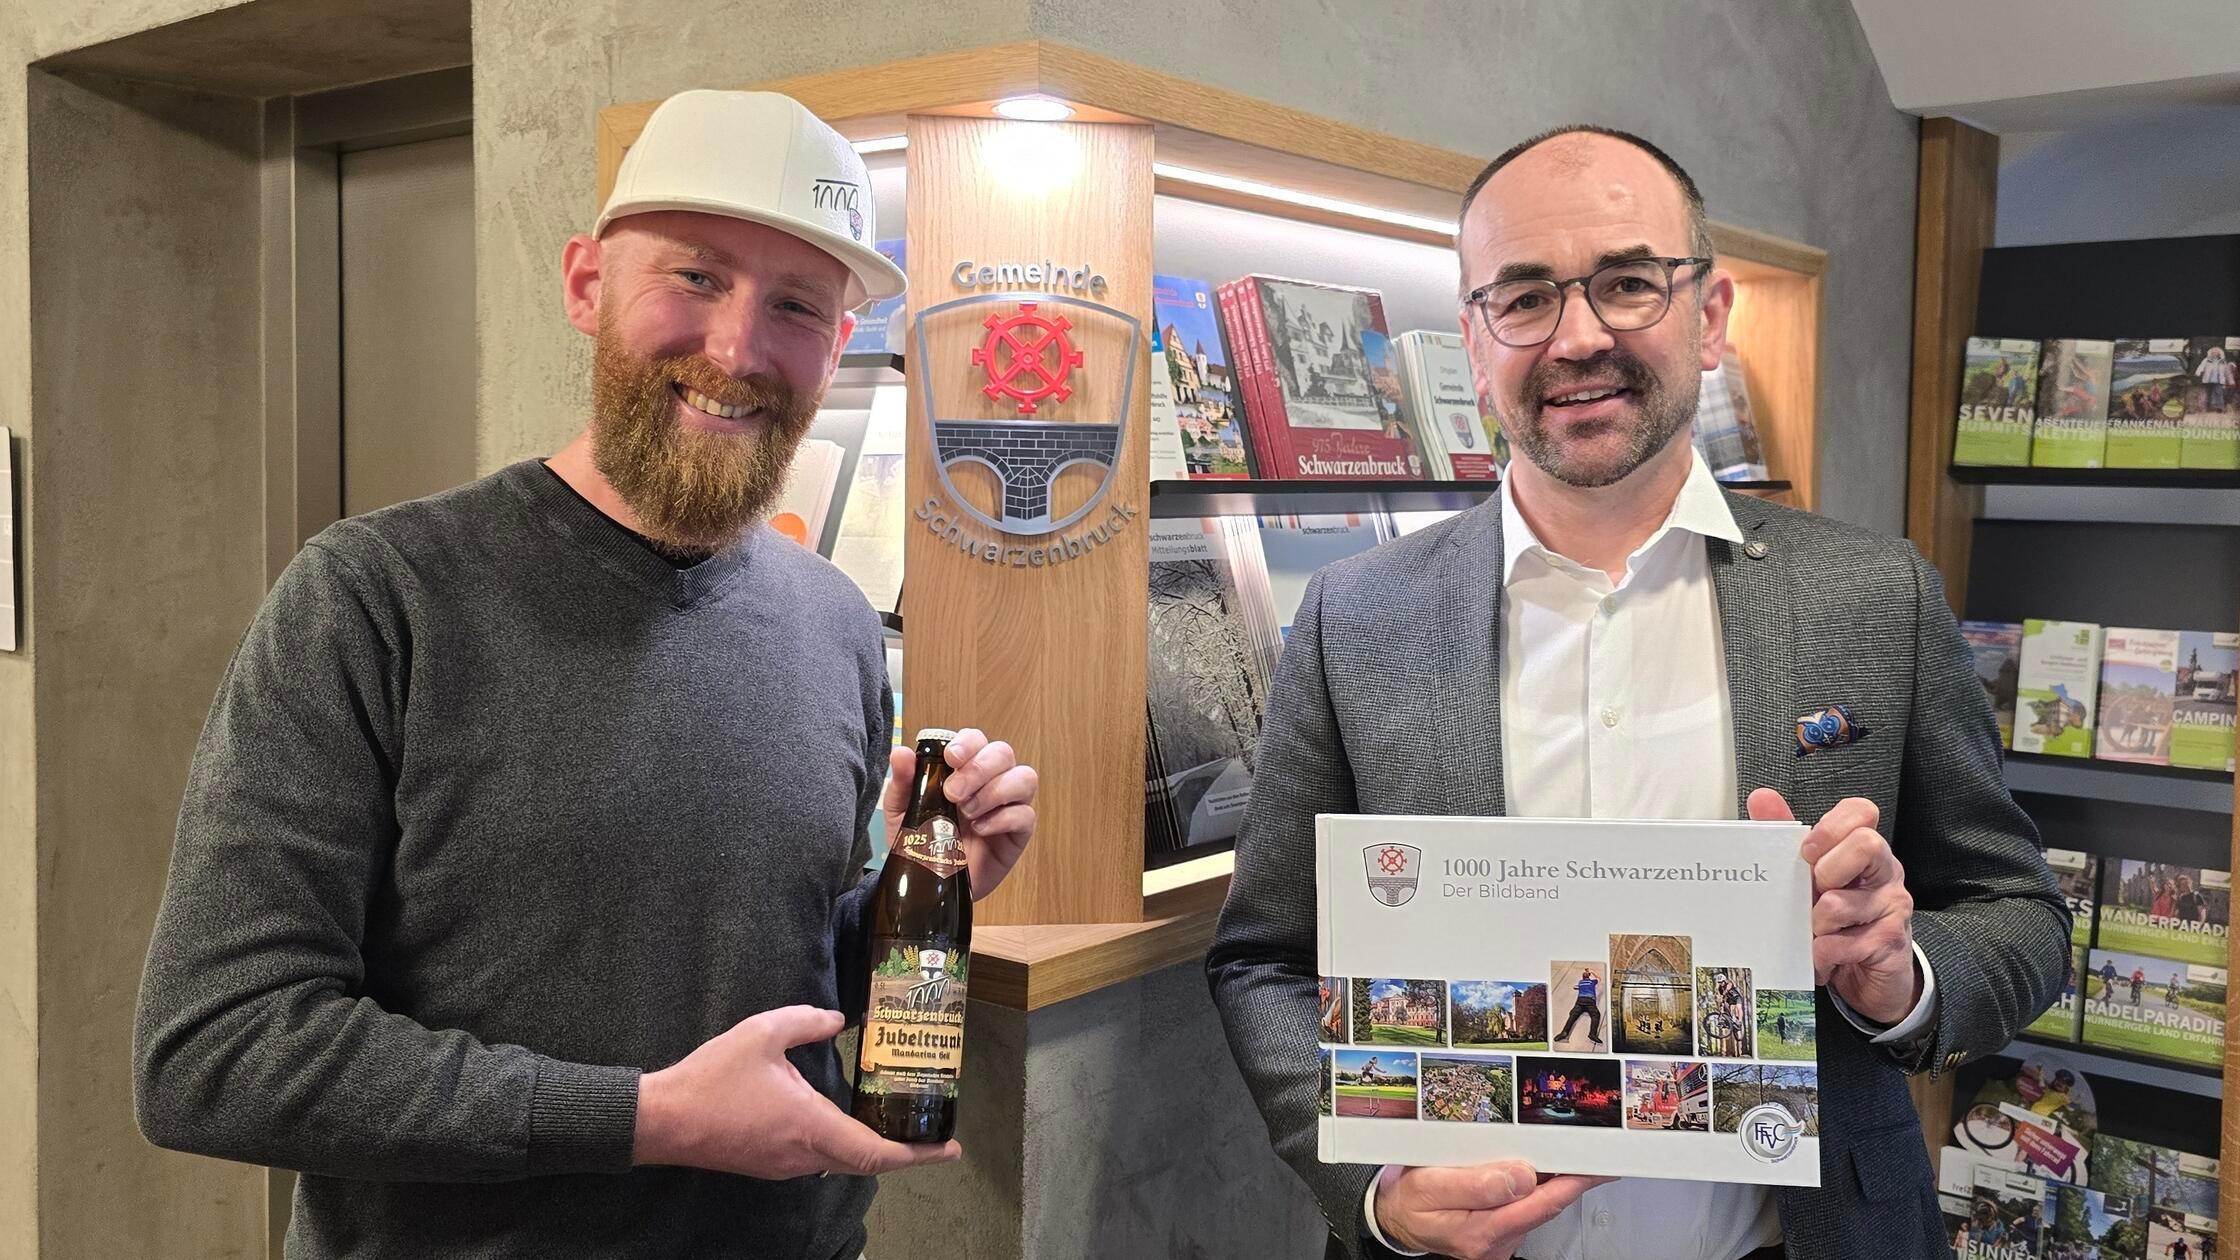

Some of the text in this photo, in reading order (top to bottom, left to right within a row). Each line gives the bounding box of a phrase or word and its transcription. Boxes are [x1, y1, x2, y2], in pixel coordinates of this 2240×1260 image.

[953, 259, 1108, 295] Gemeinde
[1959, 403, 2034, 424] SEVEN
[1312, 439, 1332, 453] 975
[1299, 453, 1406, 477] Schwarzenbruck
[914, 496, 1140, 568] Schwarzenbruck
[1151, 544, 1208, 557] Mitteilungsblatt
[2172, 710, 2237, 727] CAMPIN
[903, 834, 928, 847] 1025
[1443, 858, 1769, 882] 1000 Jahre Schwarzenbruck
[1442, 883, 1559, 900] Der Bildband
[2171, 930, 2199, 943] LAND
[2085, 998, 2225, 1036] RADELPARADIE
[2153, 1026, 2181, 1040] LAND
[891, 1049, 936, 1060] Mandarina
